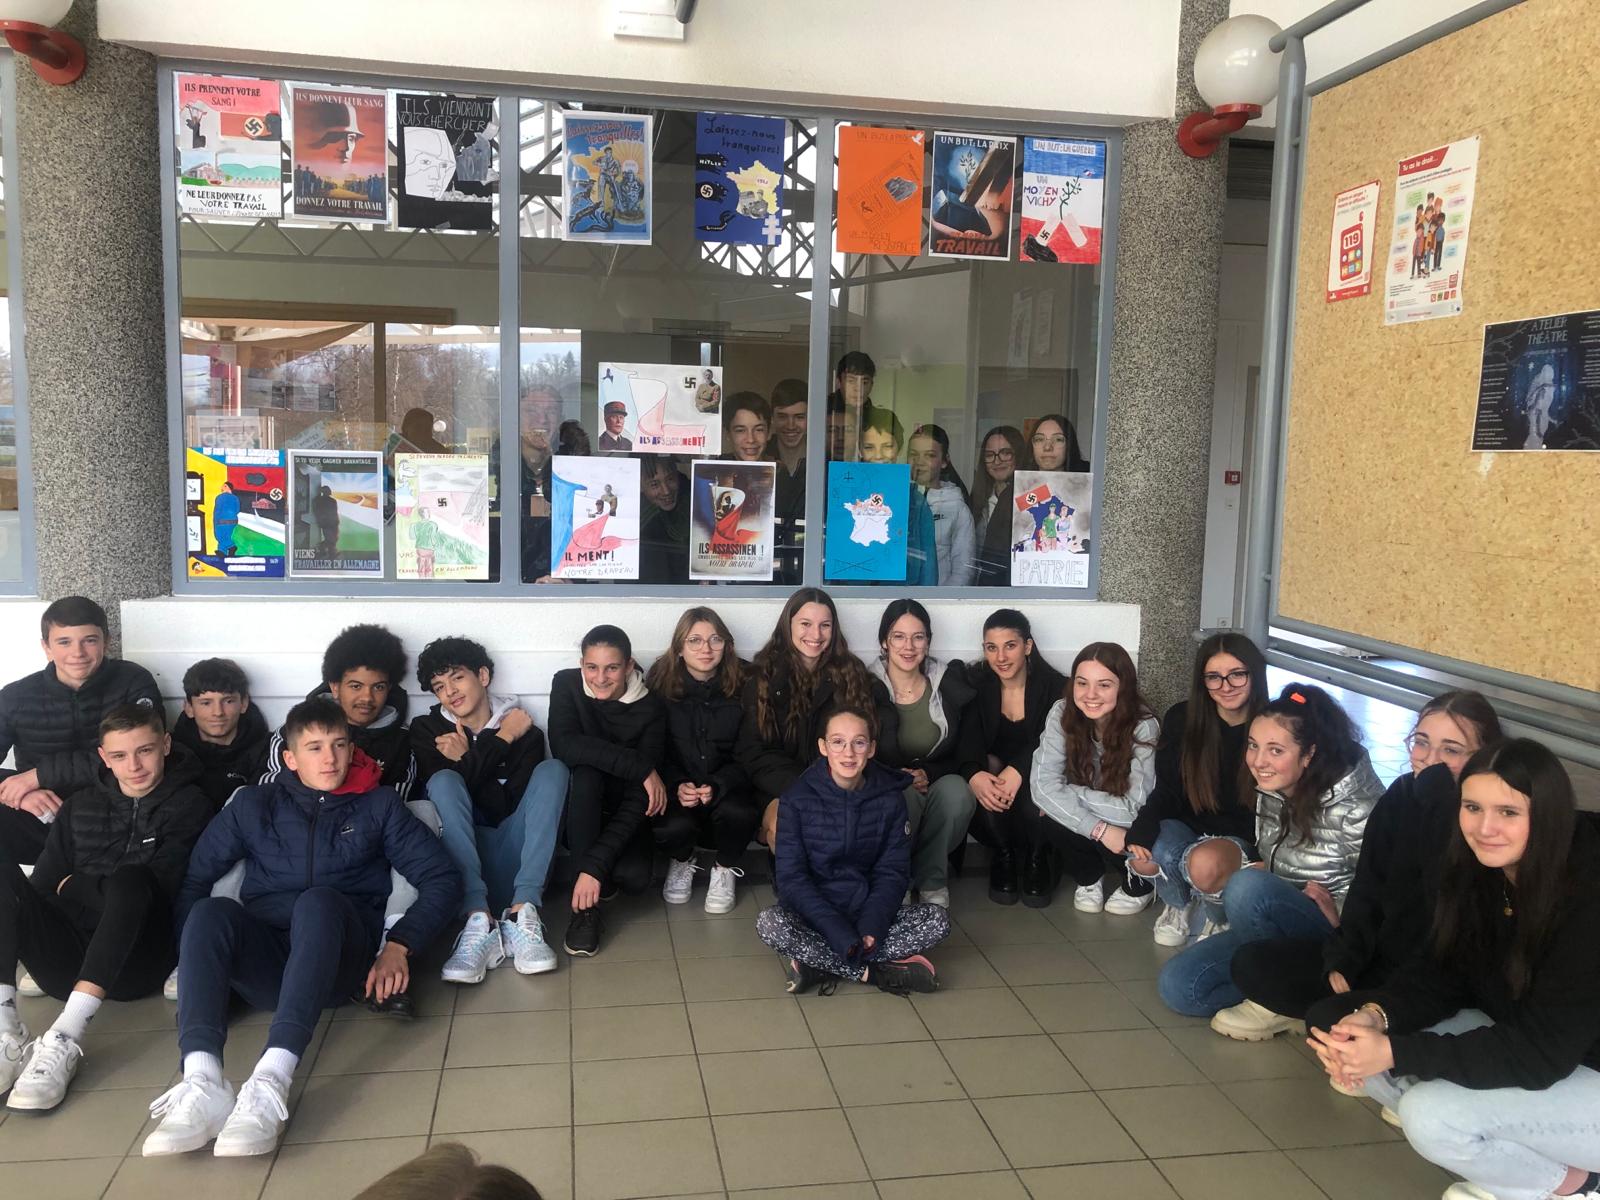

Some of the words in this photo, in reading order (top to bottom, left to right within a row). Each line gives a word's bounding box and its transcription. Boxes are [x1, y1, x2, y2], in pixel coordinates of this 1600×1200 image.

[184, 83, 196, 92] ILS
[199, 84, 236, 95] PRENNENT
[237, 87, 261, 97] VOTRE
[363, 100, 384, 108] SANG
[401, 98, 431, 116] ILS
[439, 100, 493, 119] VIENDRONT
[397, 112, 421, 126] VOUS
[423, 115, 486, 131] CHERCHER
[941, 136, 954, 144] UN
[977, 139, 987, 148] LA
[1036, 175, 1048, 184] UN
[186, 190, 195, 198] NE
[197, 190, 216, 200] LEUR
[216, 192, 245, 201] DONNEZ
[246, 193, 262, 203] PAS
[1023, 186, 1059, 196] MOYEN
[200, 200, 229, 209] VOTRE
[233, 201, 267, 210] TRAVAIL
[296, 196, 325, 207] DONNEZ
[327, 198, 352, 209] VOTRE
[354, 200, 384, 211] TRAVAIL
[1026, 195, 1056, 206] VICHY
[1344, 233, 1359, 247] 119
[936, 239, 1001, 255] TRAVAIL
[294, 549, 316, 559] VIENS
[698, 543, 710, 554] ILS
[565, 551, 573, 561] IL
[1019, 559, 1084, 586] PATRIE
